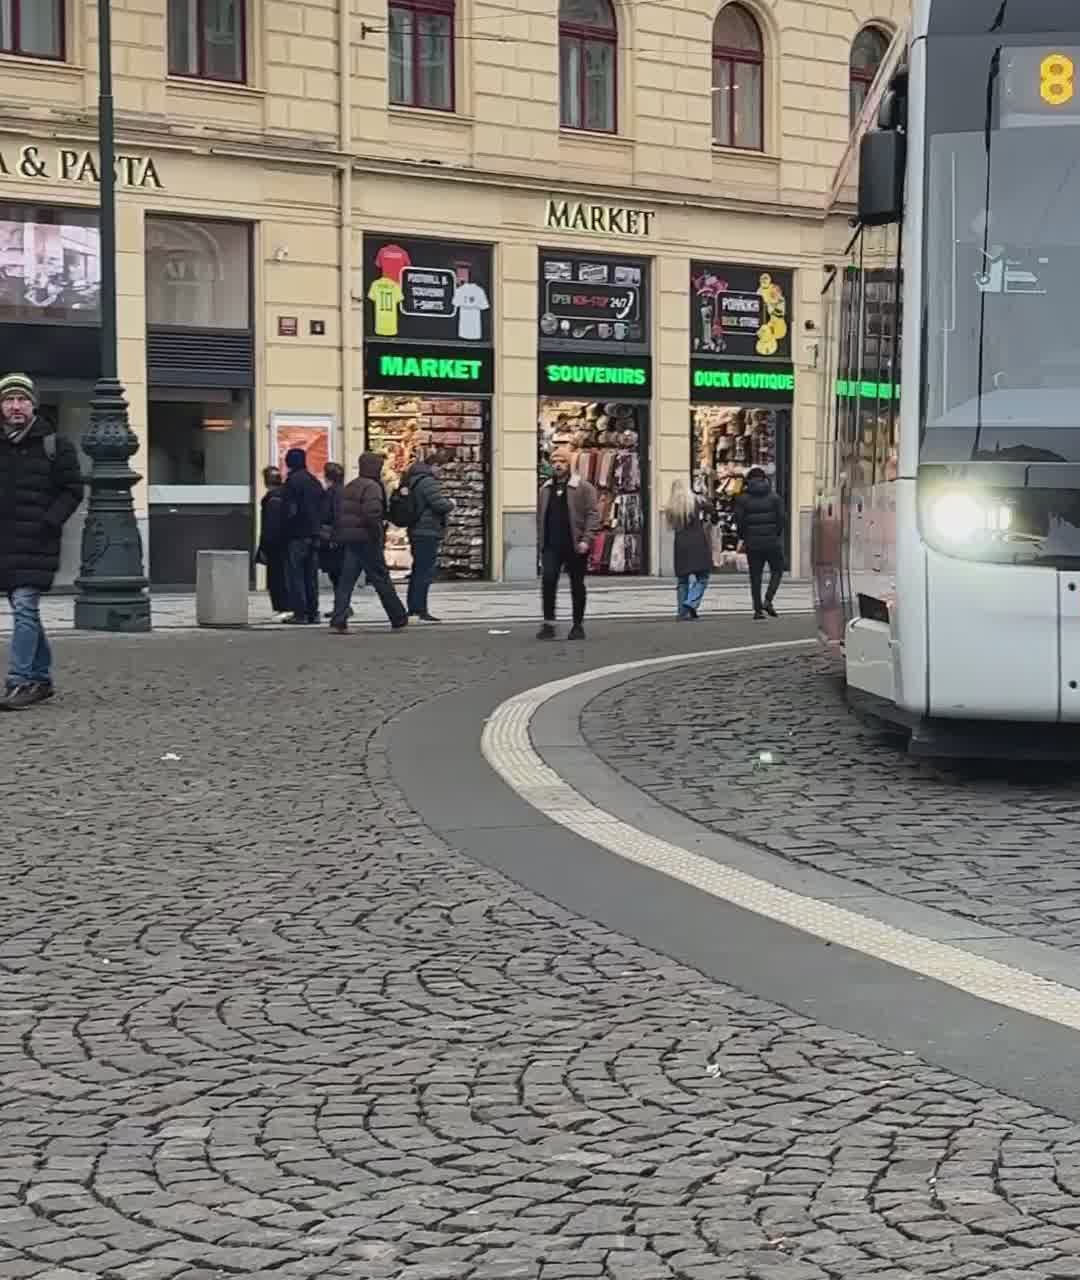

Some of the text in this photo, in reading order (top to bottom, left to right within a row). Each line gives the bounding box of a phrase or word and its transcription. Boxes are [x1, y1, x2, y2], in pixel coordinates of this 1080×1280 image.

[1040, 54, 1074, 105] 8
[19, 146, 50, 178] &
[60, 150, 165, 189] PATA
[546, 200, 655, 236] MARKET
[380, 356, 482, 379] MARKET
[547, 365, 646, 385] SOUVENIRS
[694, 370, 795, 391] DUCK BOUTIQUE
